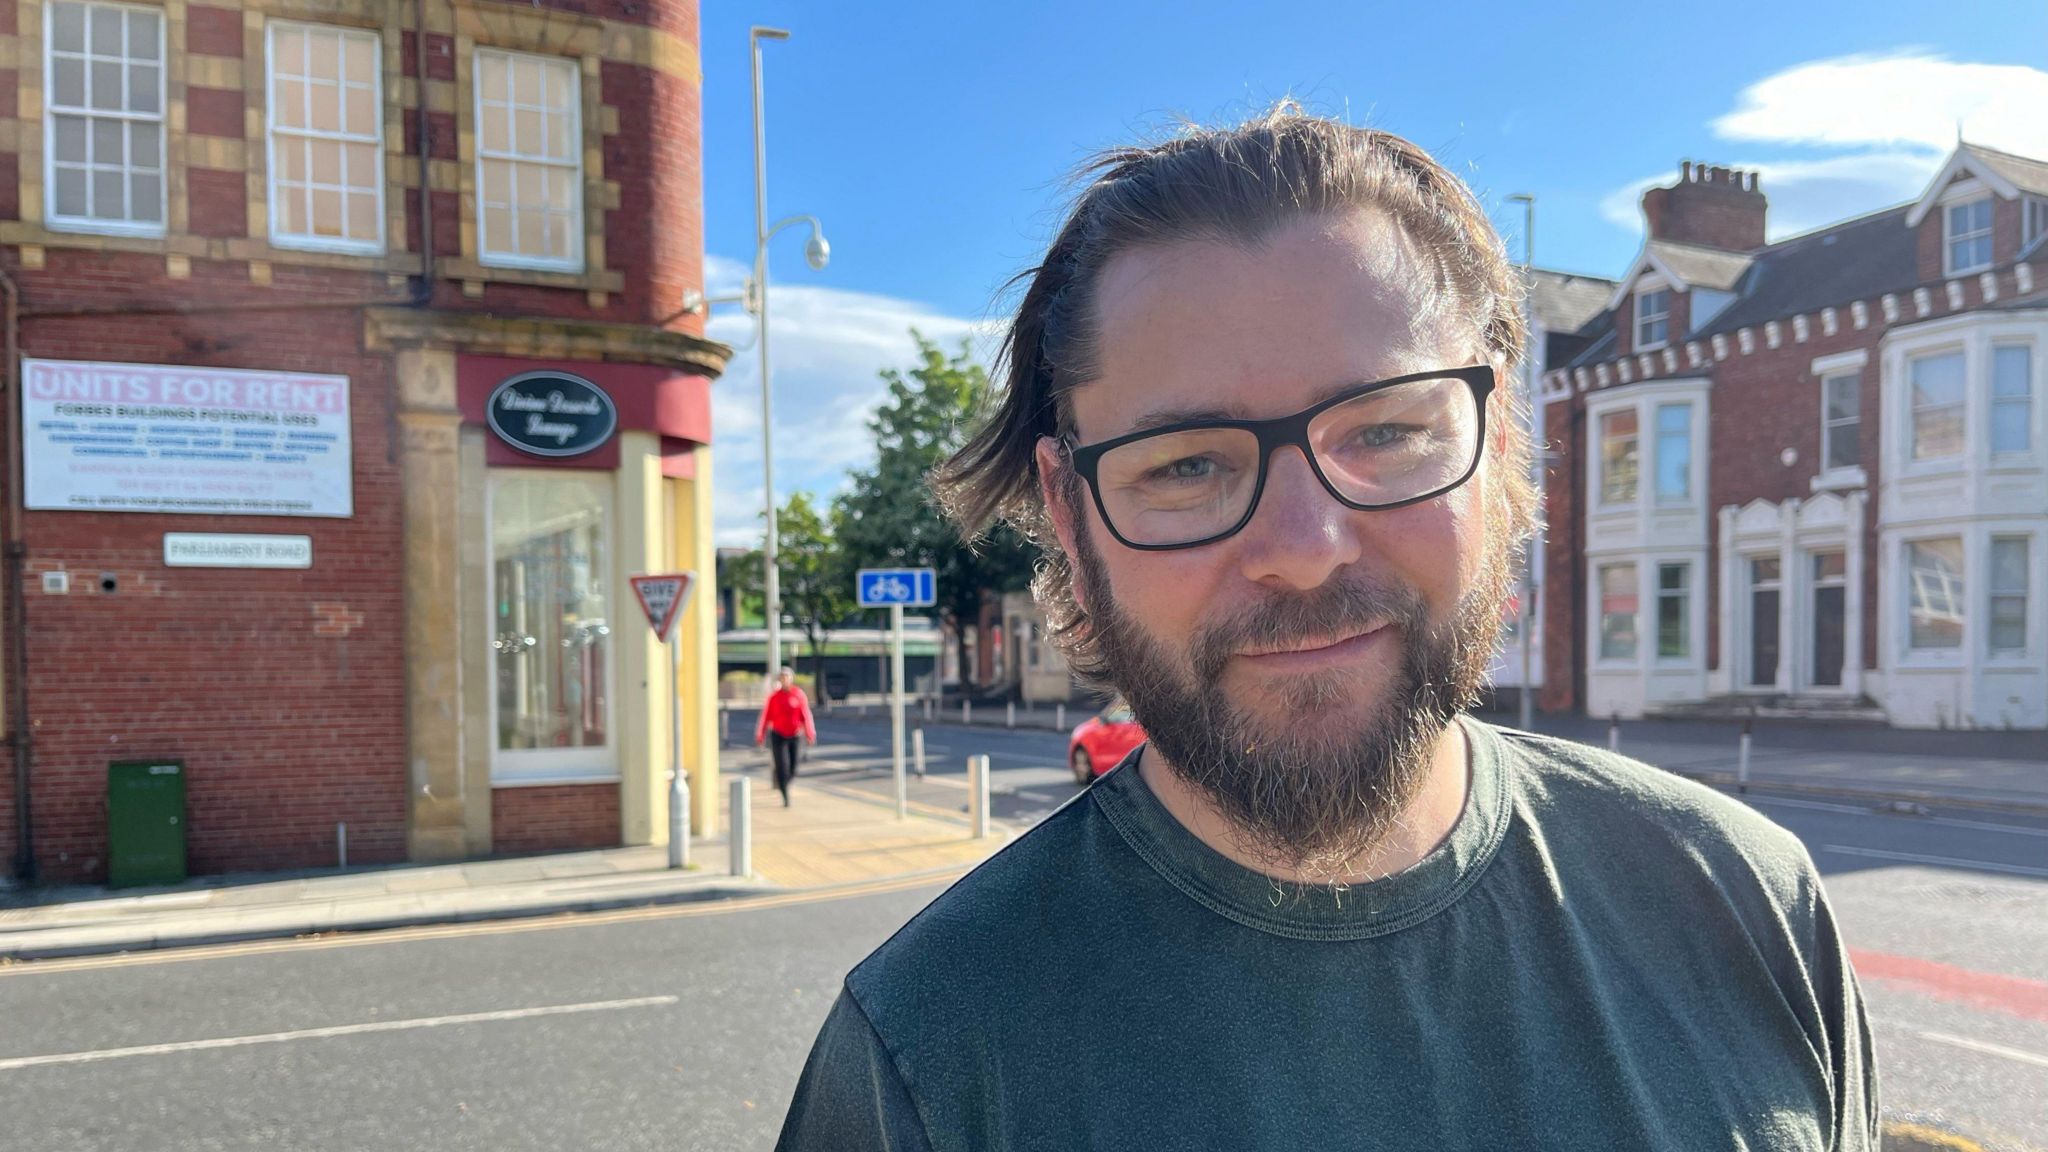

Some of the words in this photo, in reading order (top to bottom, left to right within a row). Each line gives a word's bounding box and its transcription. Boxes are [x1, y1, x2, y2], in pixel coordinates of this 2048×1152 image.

[34, 370, 149, 402] UNITS
[159, 375, 237, 406] FOR
[246, 380, 340, 411] RENT
[54, 403, 112, 418] FORBES
[117, 405, 196, 421] BUILDINGS
[200, 409, 279, 425] POTENTIAL
[170, 540, 262, 558] PARLIAMENT
[264, 543, 306, 559] ROAD
[642, 582, 676, 596] GIVE
